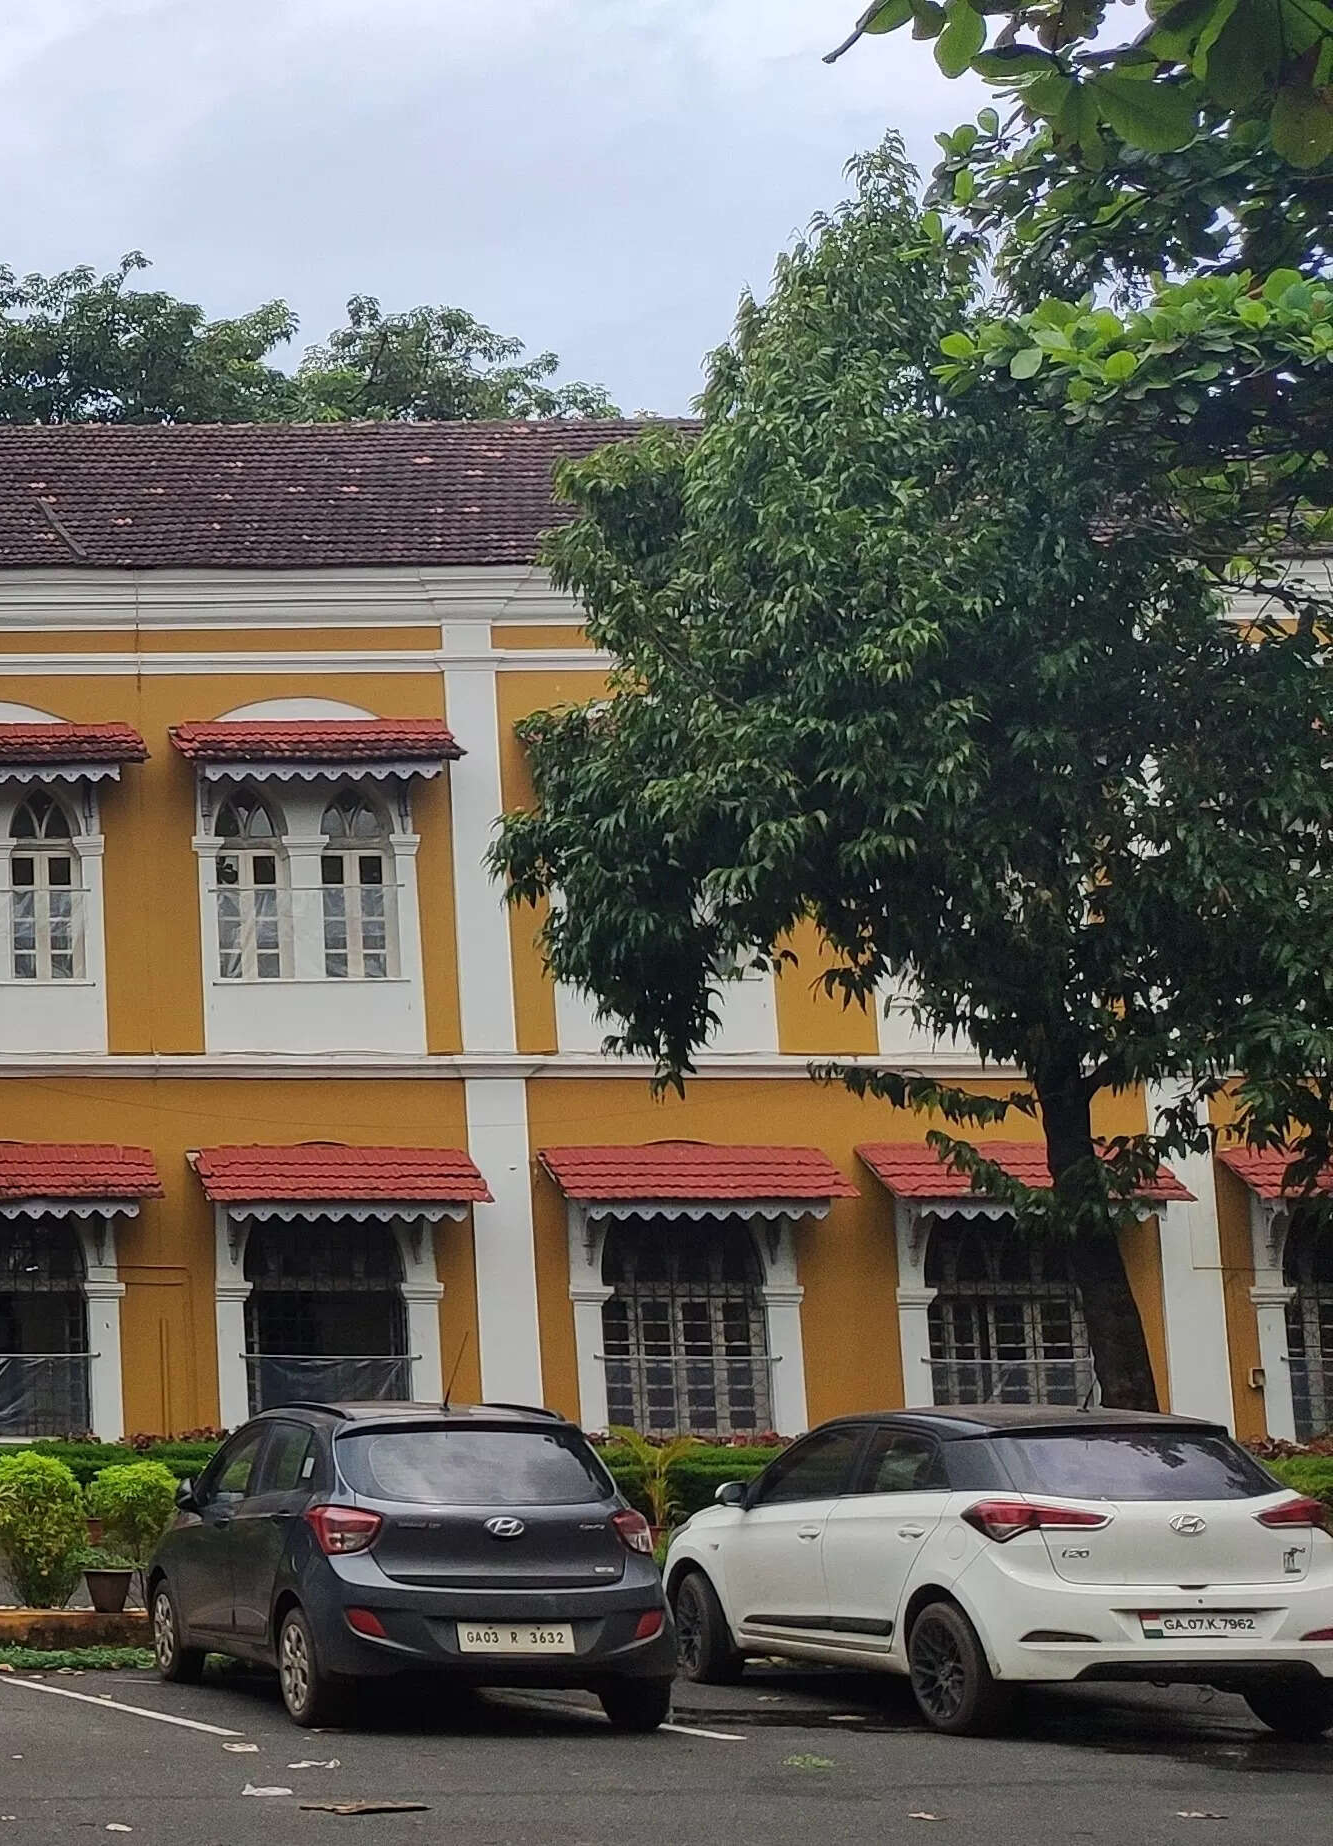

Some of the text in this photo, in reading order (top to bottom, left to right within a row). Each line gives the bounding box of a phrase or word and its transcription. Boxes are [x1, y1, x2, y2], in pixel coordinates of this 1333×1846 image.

[466, 1631, 565, 1644] GA03 R 3632
